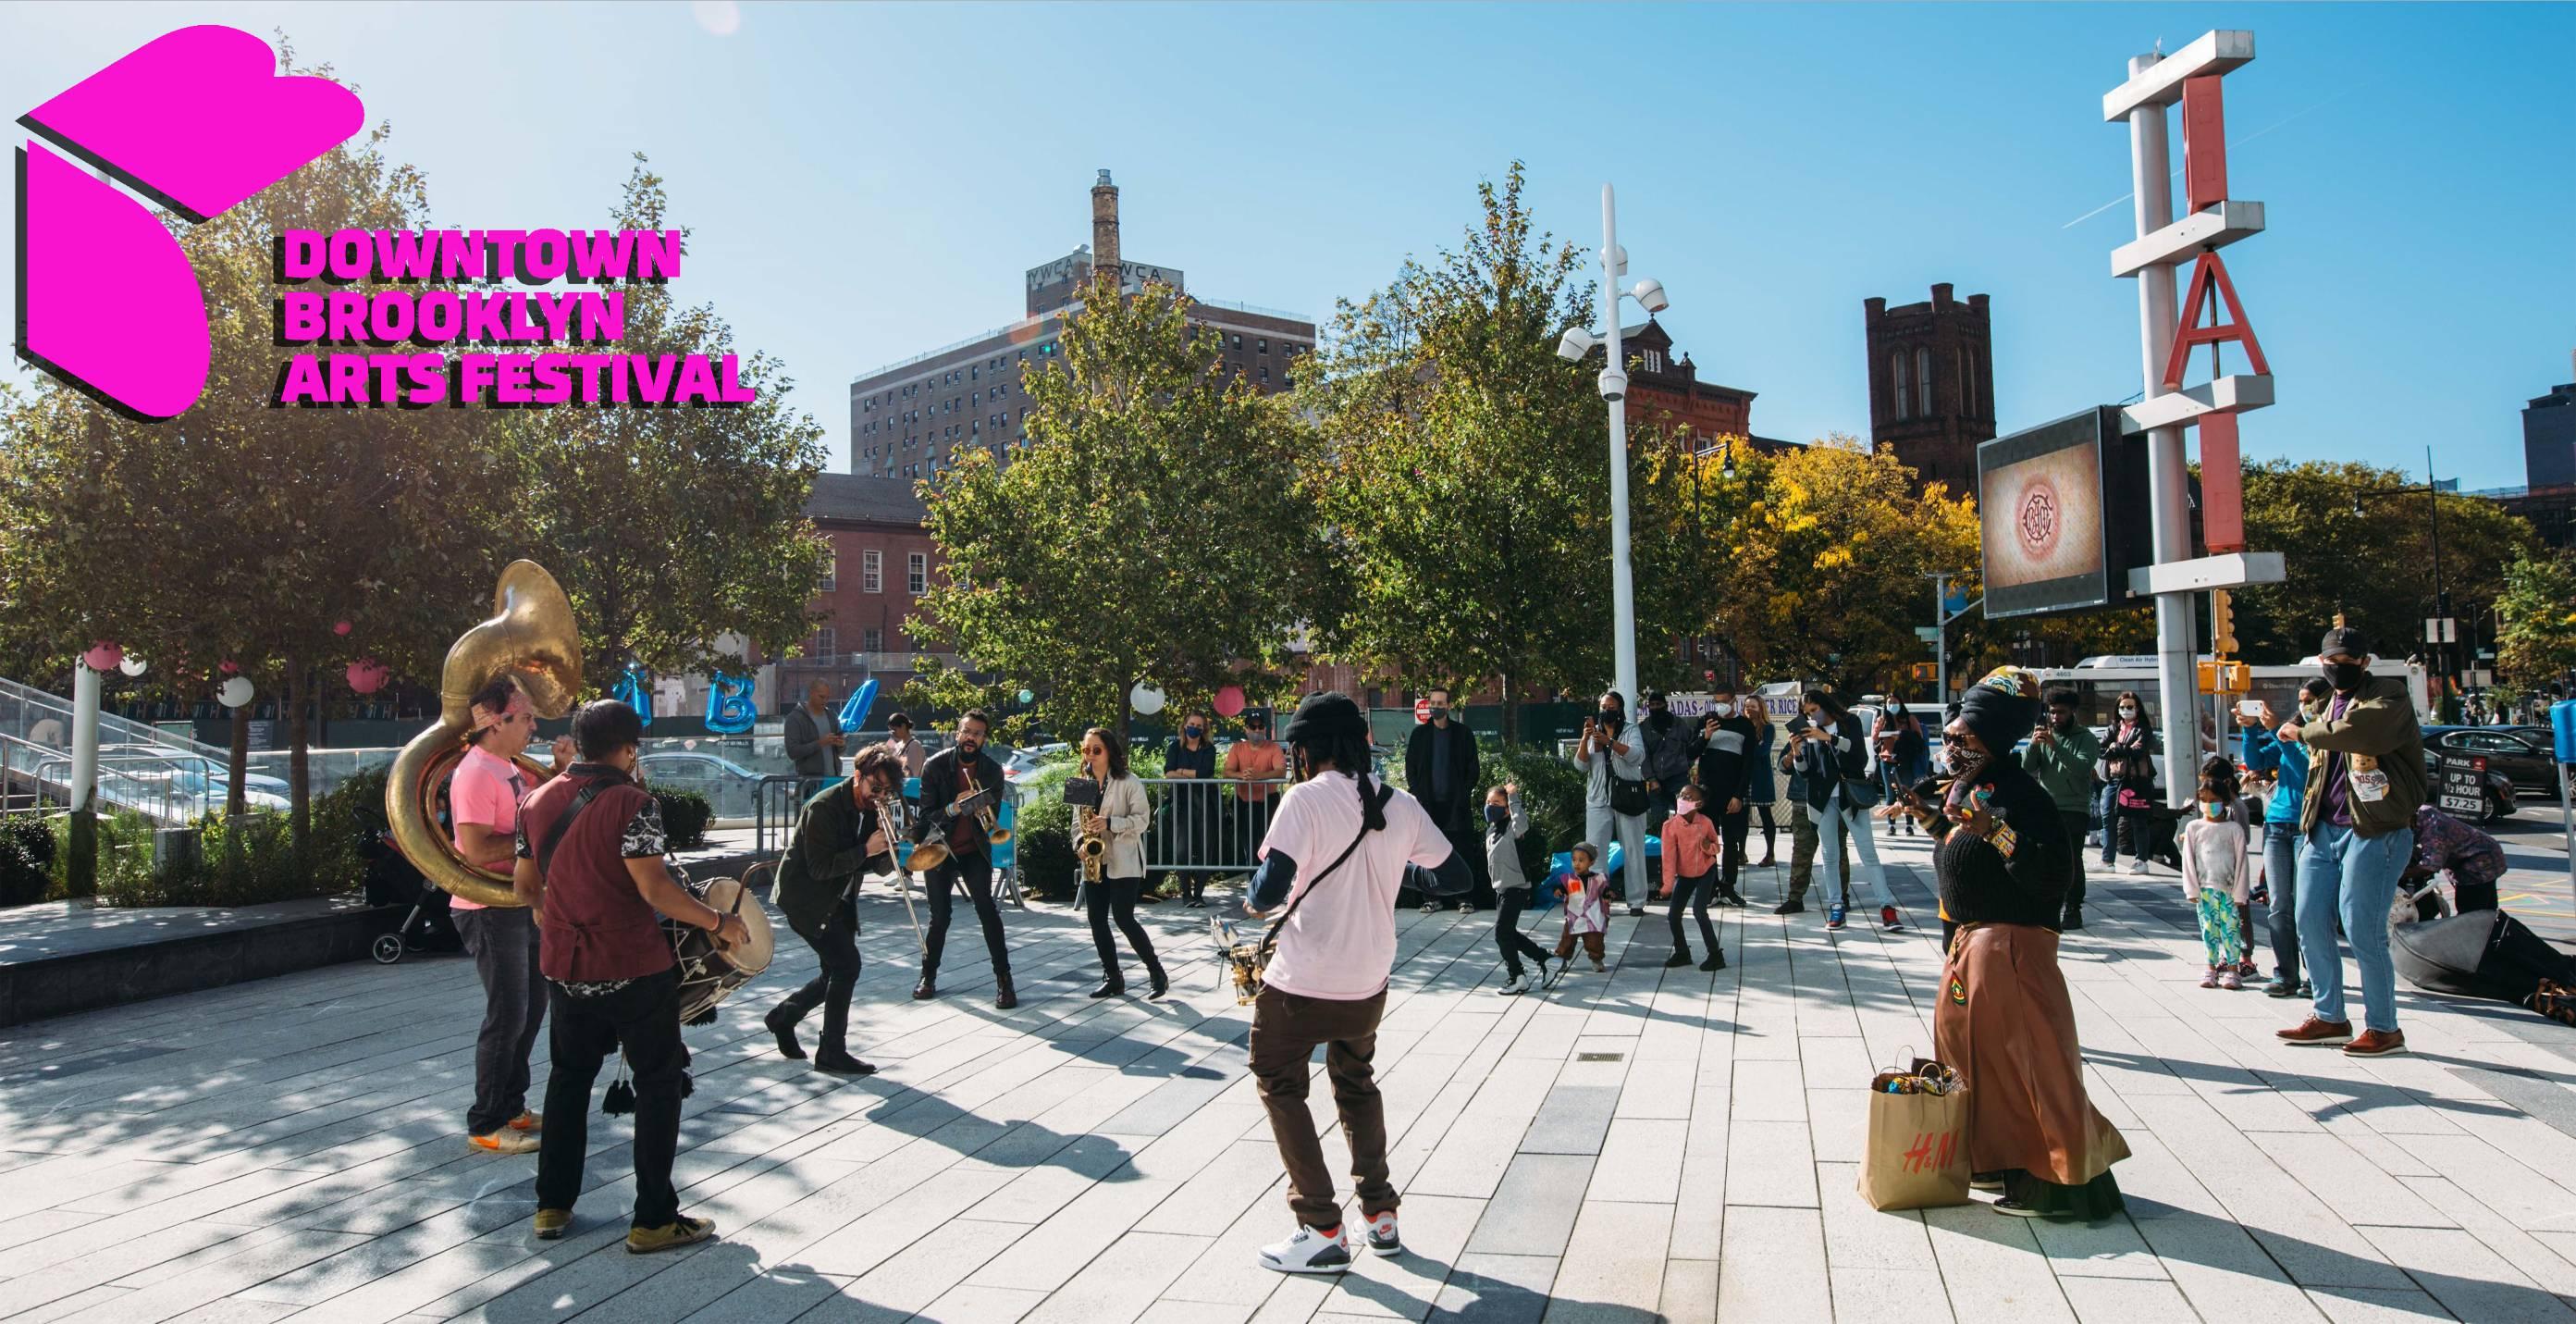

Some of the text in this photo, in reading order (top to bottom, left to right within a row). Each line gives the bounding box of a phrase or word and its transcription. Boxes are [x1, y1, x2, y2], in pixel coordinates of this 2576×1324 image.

[1029, 258, 1074, 282] YWCA
[1120, 263, 1162, 281] WCA
[1779, 699, 1798, 714] RICE
[2446, 758, 2471, 767] PARK
[2449, 773, 2476, 786] UP TO
[2456, 785, 2481, 797] HOUR
[2446, 797, 2476, 810] $7.25
[1903, 1129, 1960, 1175] H&M
